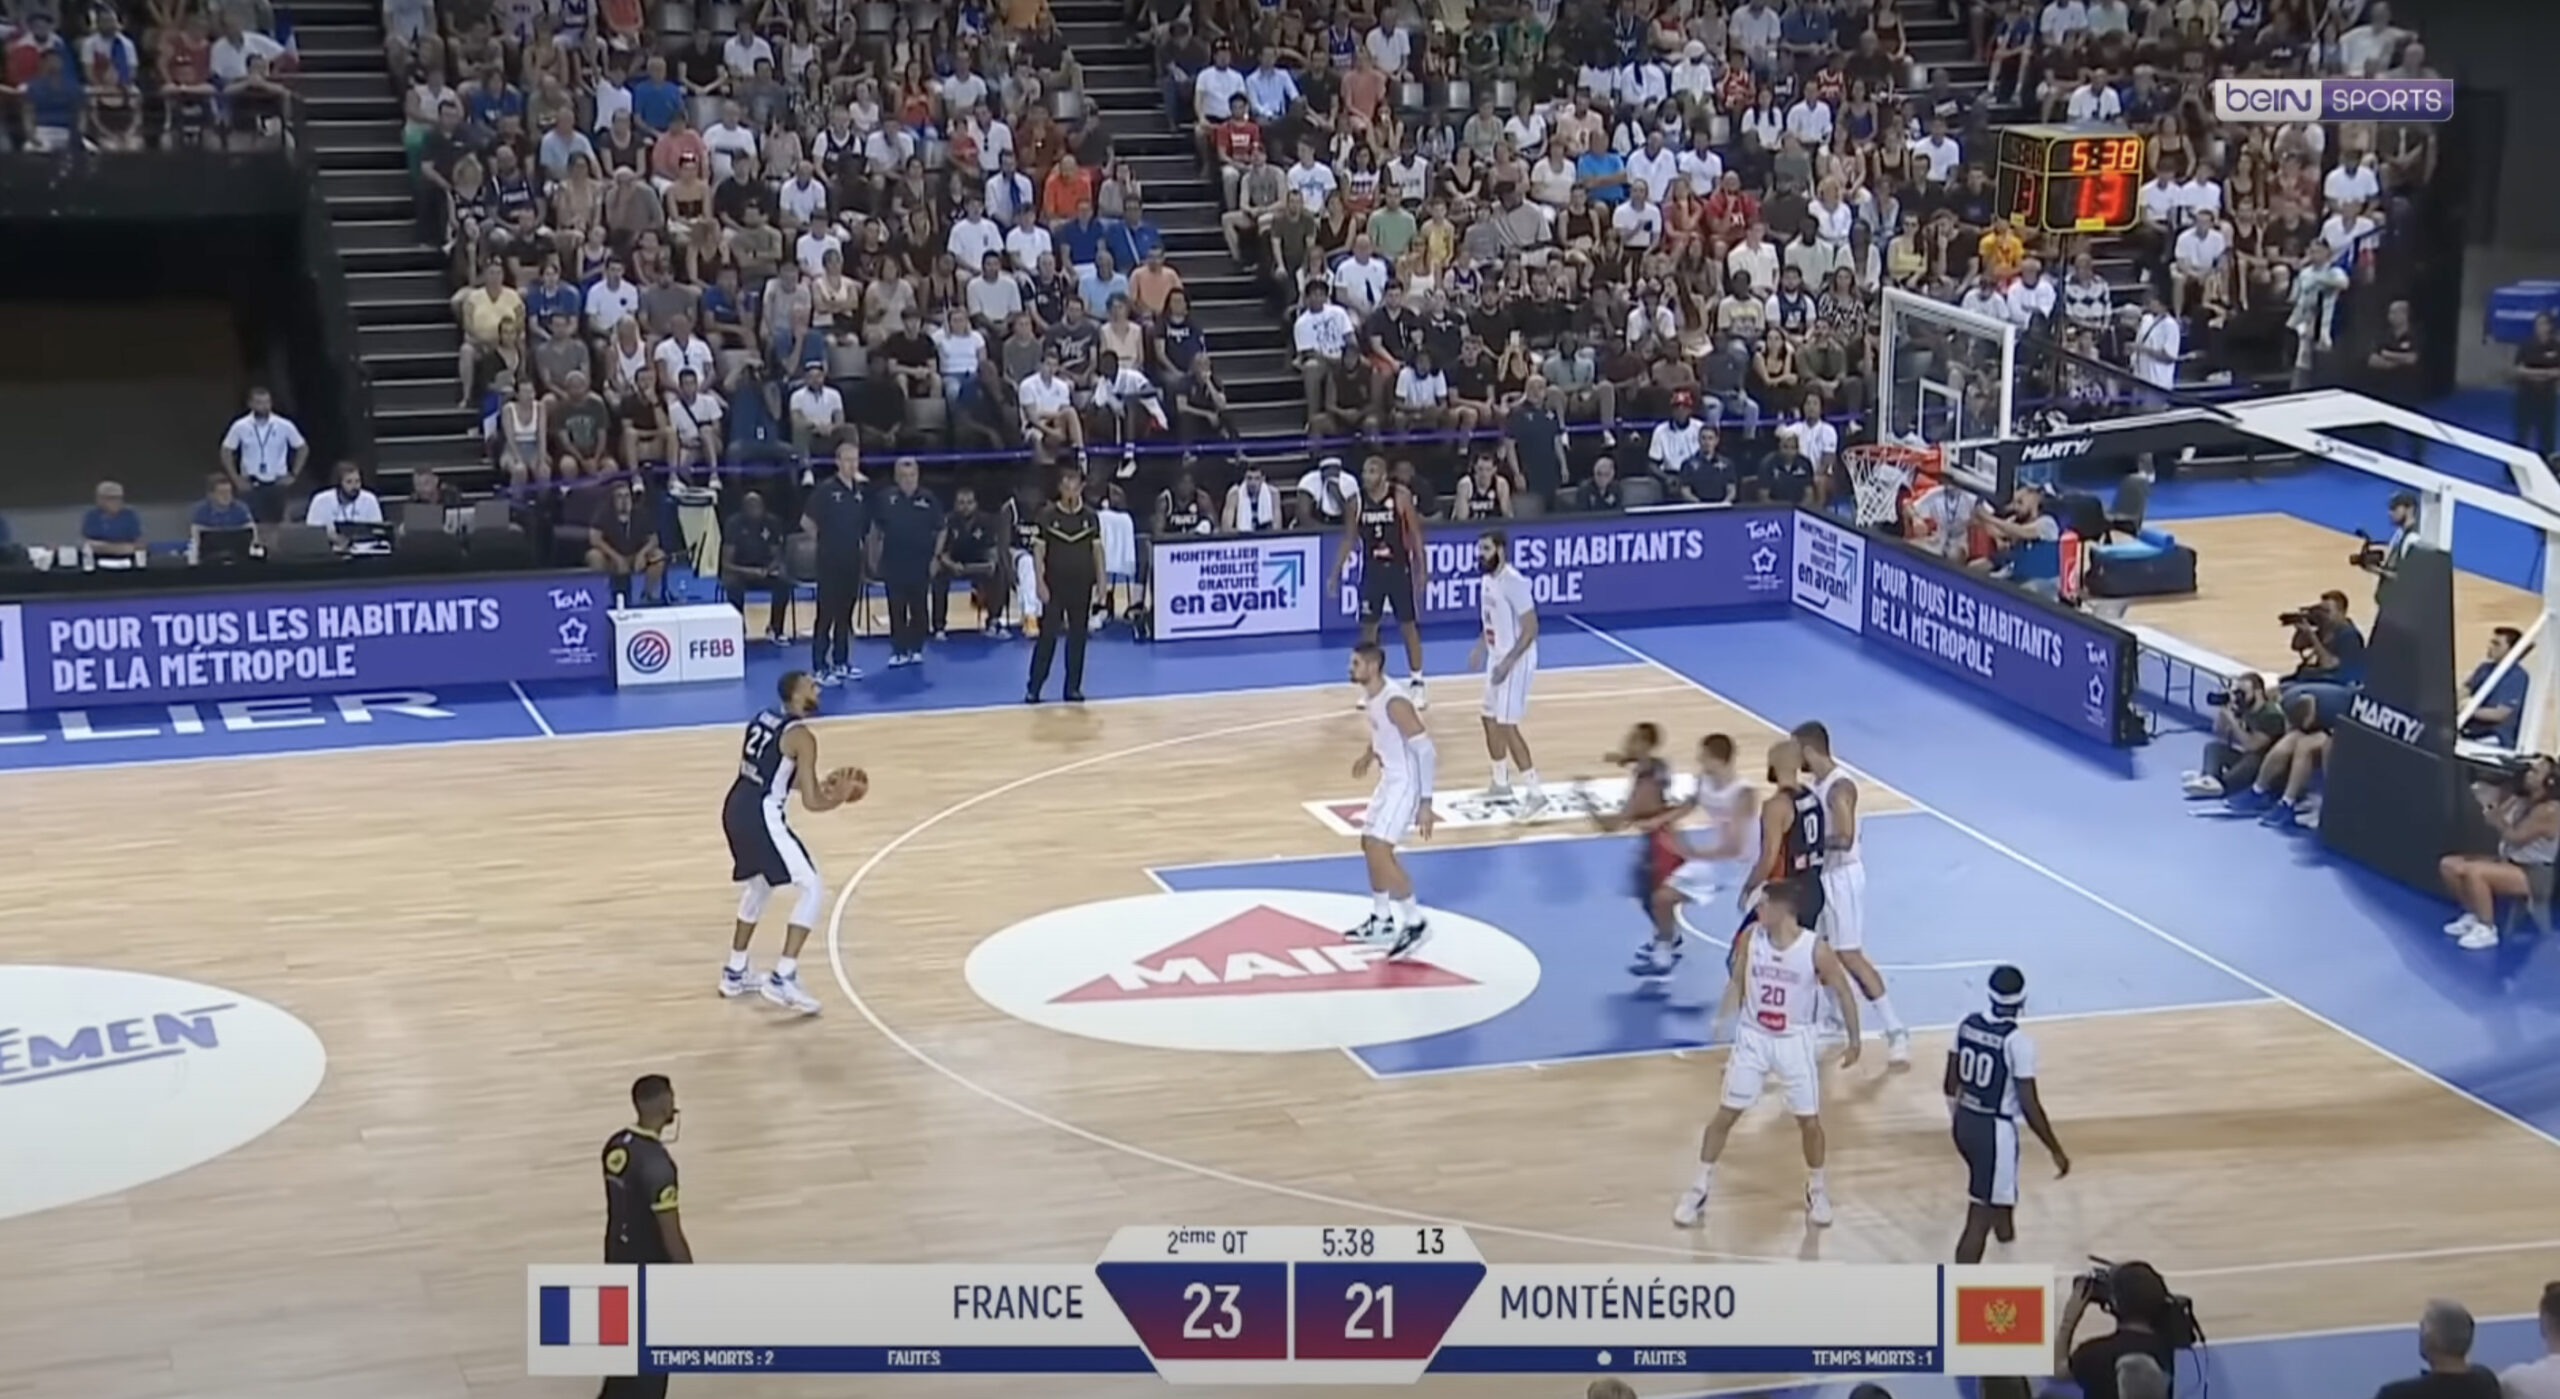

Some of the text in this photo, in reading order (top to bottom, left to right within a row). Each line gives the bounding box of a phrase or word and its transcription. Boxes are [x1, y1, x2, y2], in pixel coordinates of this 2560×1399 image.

[2072, 140, 2140, 171] 5:38
[2079, 173, 2123, 218] 13
[1170, 548, 1259, 564] MONTPELLIER
[1514, 538, 1547, 569] ES
[1554, 529, 1704, 568] HABITANTS
[1798, 562, 1813, 587] en
[1170, 592, 1205, 615] en
[1872, 559, 1909, 602] POUR
[1910, 573, 1947, 619] TOUS
[1948, 590, 1977, 630] LES
[1978, 602, 2063, 668] HABITANTS
[50, 598, 500, 653] POUR TOUS LES HABITANTS
[1871, 595, 1995, 677] DE LA MÉTROPOLE
[53, 643, 357, 693] DE LA MÉTROPOLE
[689, 638, 735, 660] FFBB
[0, 692, 457, 744] LIER
[745, 725, 773, 759] 27
[1108, 943, 1390, 991] MAIF
[1761, 984, 1786, 1008] 20
[1960, 1047, 1994, 1088] 00
